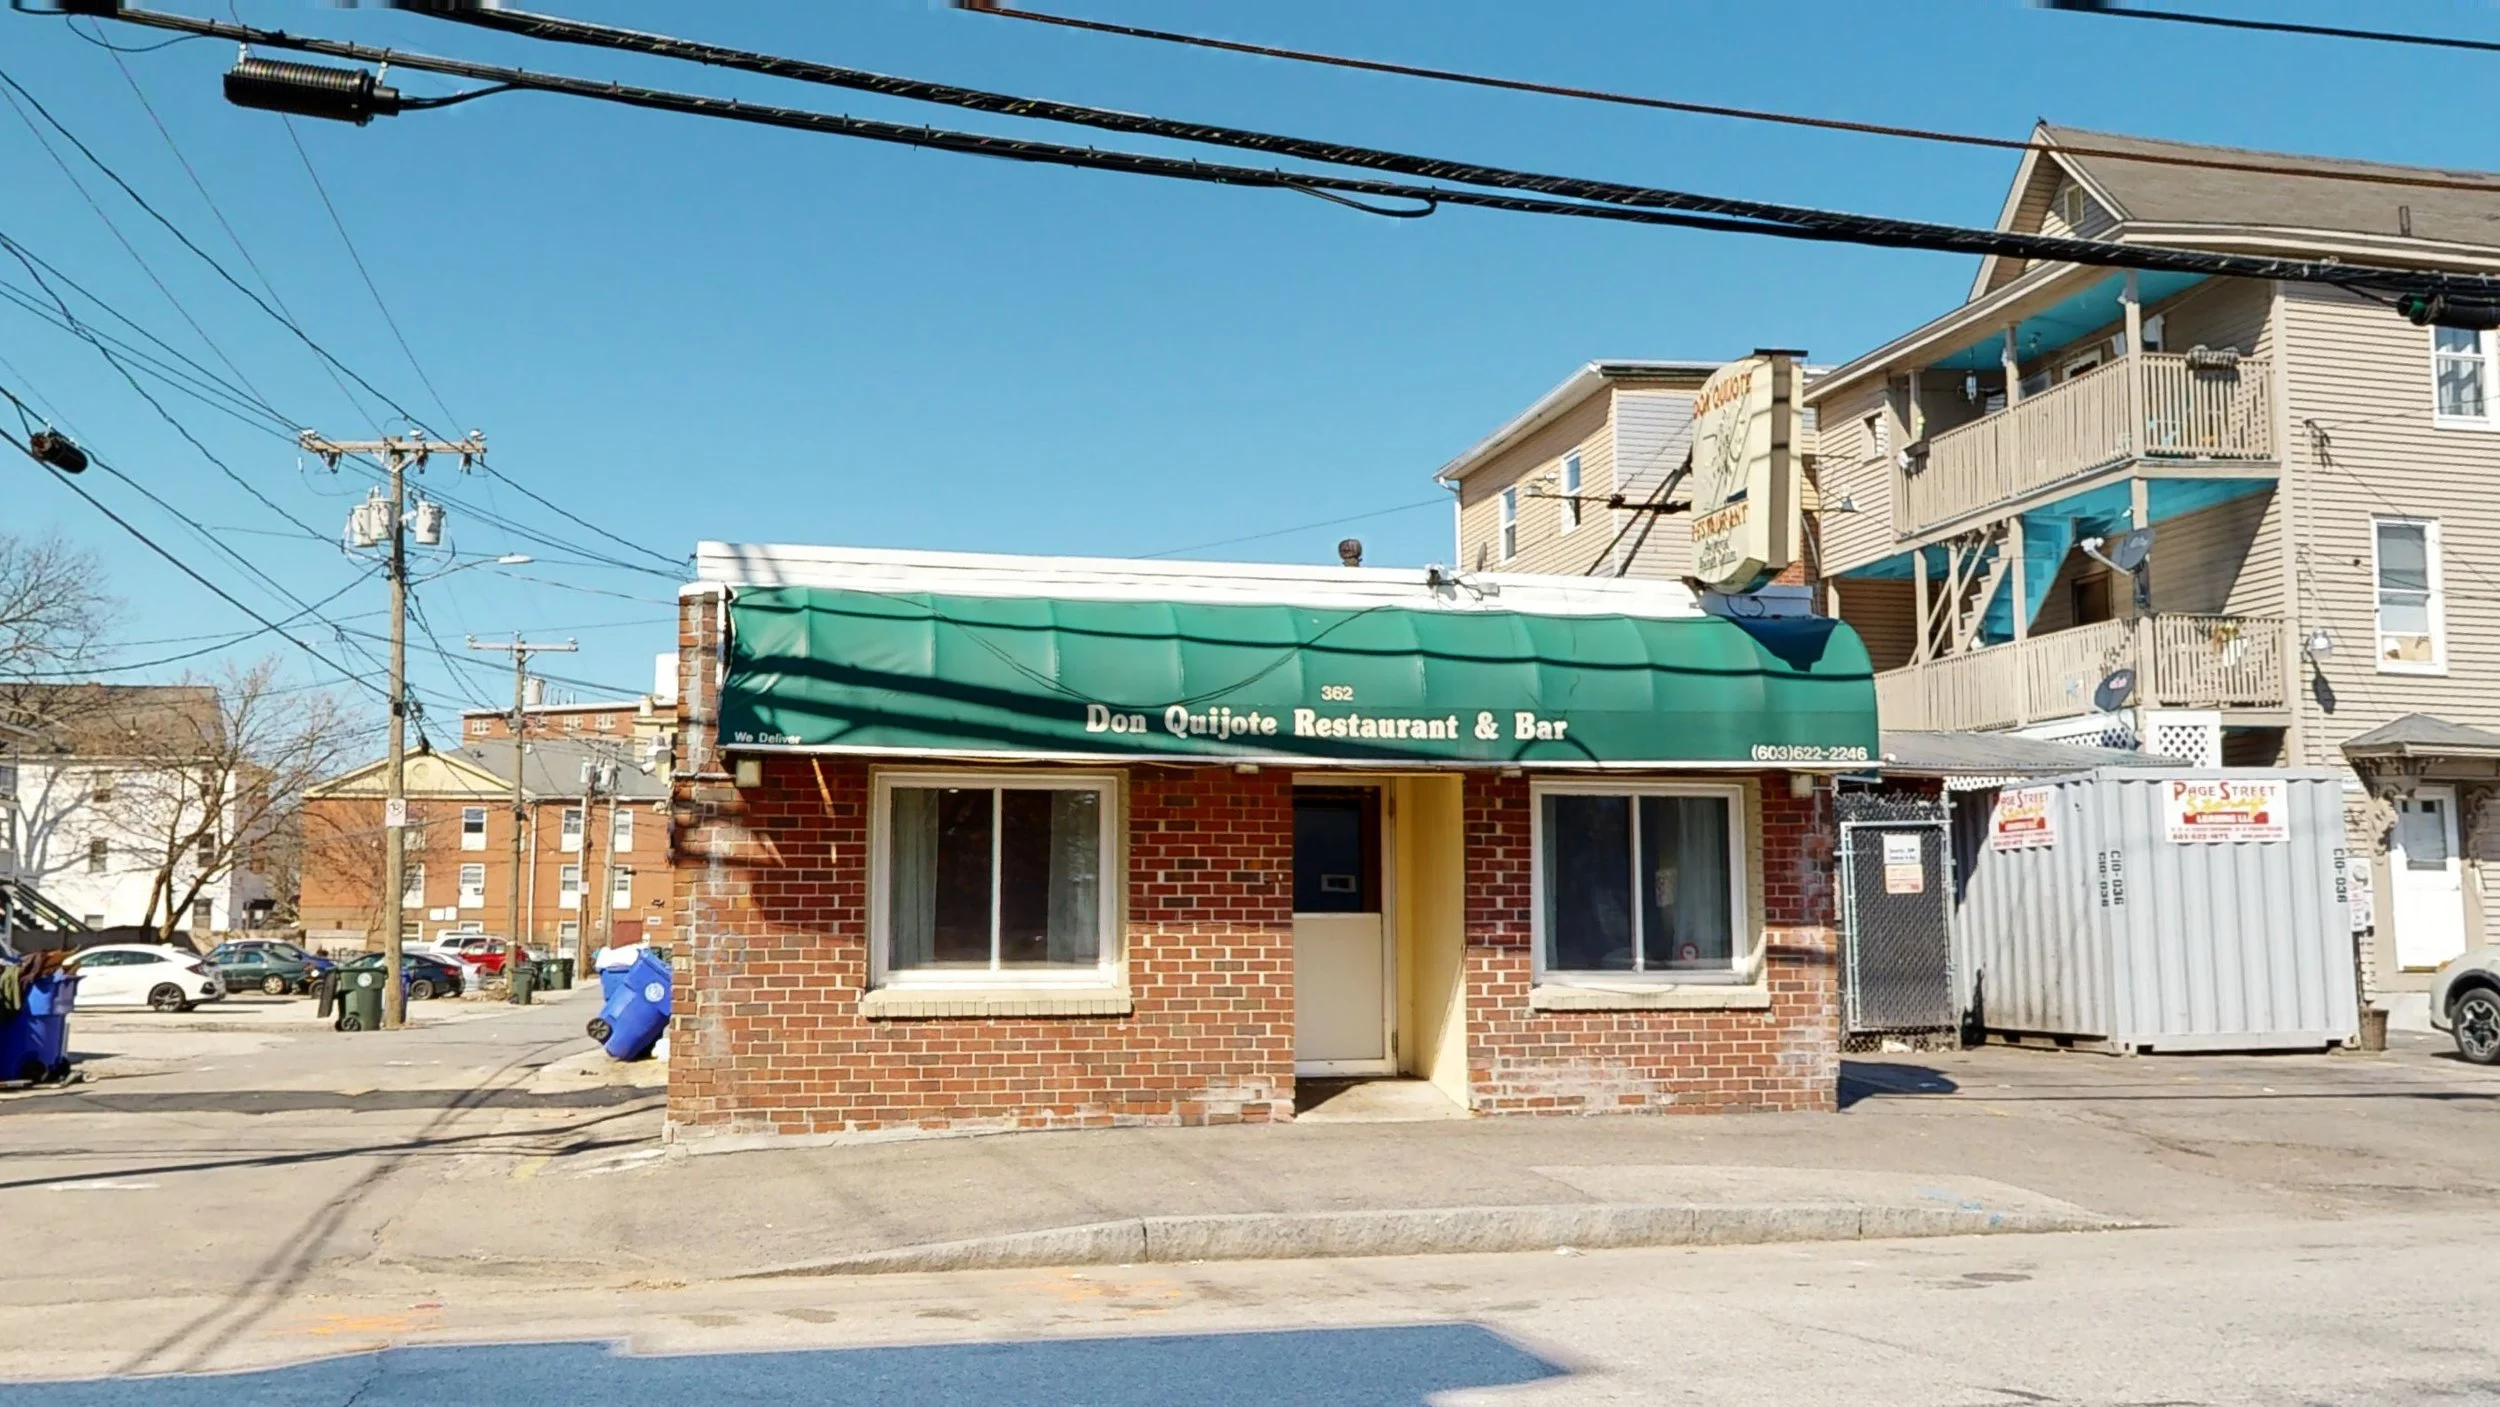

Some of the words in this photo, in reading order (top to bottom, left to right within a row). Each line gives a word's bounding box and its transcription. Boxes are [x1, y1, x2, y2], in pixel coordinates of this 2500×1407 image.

[1321, 685, 1354, 701] 362
[1086, 704, 1147, 733] Don
[1163, 704, 1278, 740] Quijote
[1293, 708, 1459, 739] Restaurant
[1474, 711, 1500, 740] &
[1514, 712, 1569, 740] Bar
[734, 731, 754, 743] We
[758, 732, 802, 745] Deliver
[1751, 744, 1868, 761] (603)622-2246
[2173, 782, 2216, 801] PAGE
[2219, 782, 2277, 801] STREET
